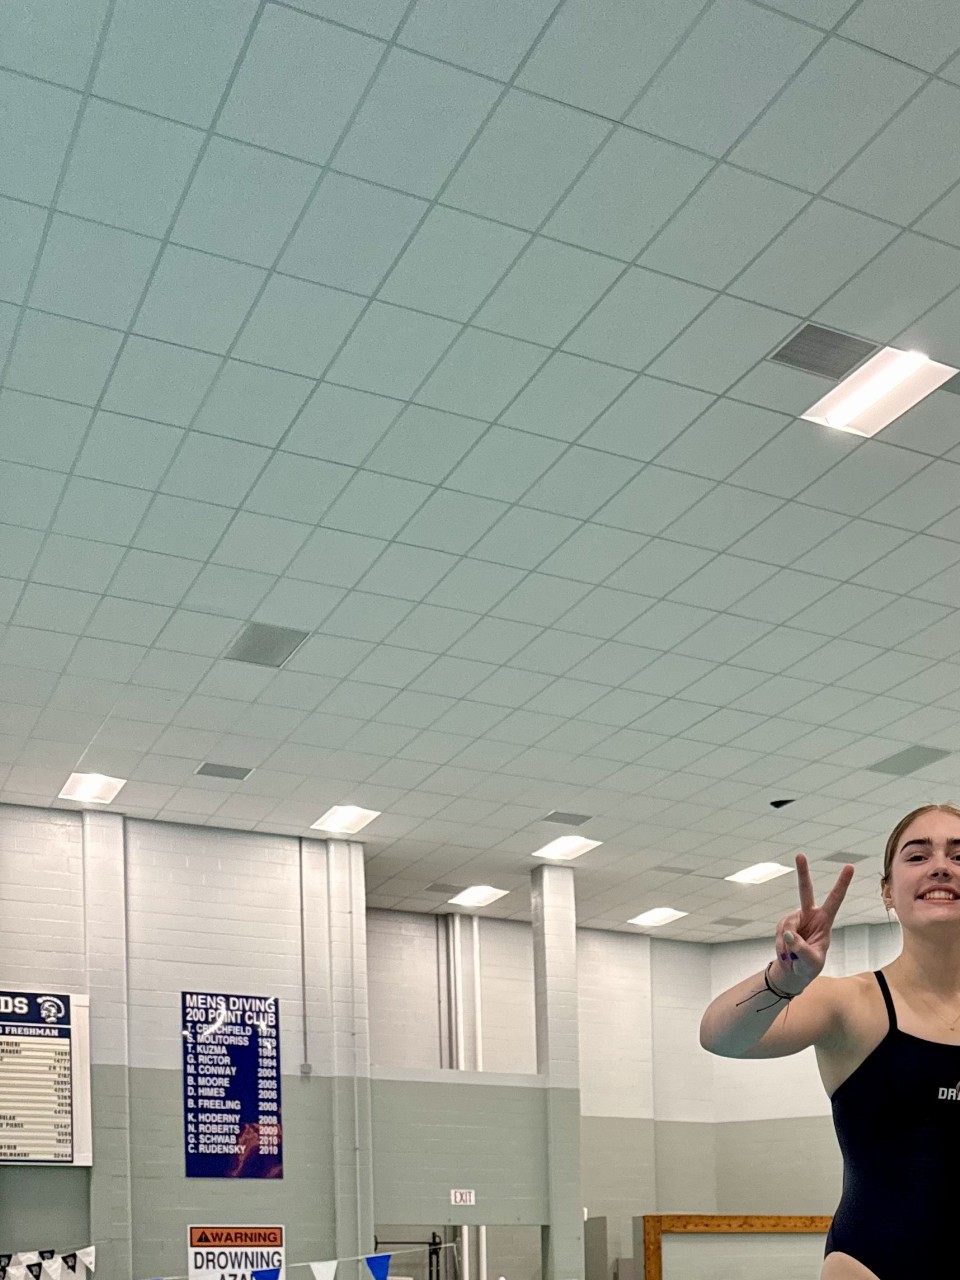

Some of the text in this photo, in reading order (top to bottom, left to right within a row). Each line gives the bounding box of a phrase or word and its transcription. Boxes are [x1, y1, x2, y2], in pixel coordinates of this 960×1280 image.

[186, 994, 276, 1012] MENS DIVING
[186, 1008, 276, 1026] 200 POINT CLUB
[5, 1026, 59, 1036] FRESHMAN
[186, 1023, 195, 1033] T.
[196, 1024, 253, 1036] CRCHFIELD
[187, 1034, 196, 1043] S.
[197, 1034, 250, 1046] MOLITORISS
[187, 1044, 195, 1053] T.
[196, 1045, 228, 1055] KUZMA
[187, 1054, 277, 1067] G. RICTOR 1994
[186, 1065, 277, 1077] M. CONWAY 2004
[187, 1076, 278, 1089] B. MOORE 2005
[187, 1087, 278, 1099] D. HIMES 2006
[187, 1099, 278, 1111] B. FREELING 2008
[187, 1113, 278, 1125] K. HODERNY 2008
[188, 1124, 278, 1135] N. ROBERTS 2009
[188, 1134, 278, 1145] G. SCHWAB 2010
[188, 1144, 278, 1155] C. RUDENSKY 2010
[454, 1190, 472, 1204] EXIT
[210, 1232, 278, 1243] WARNING
[194, 1251, 282, 1270] DROWNING
